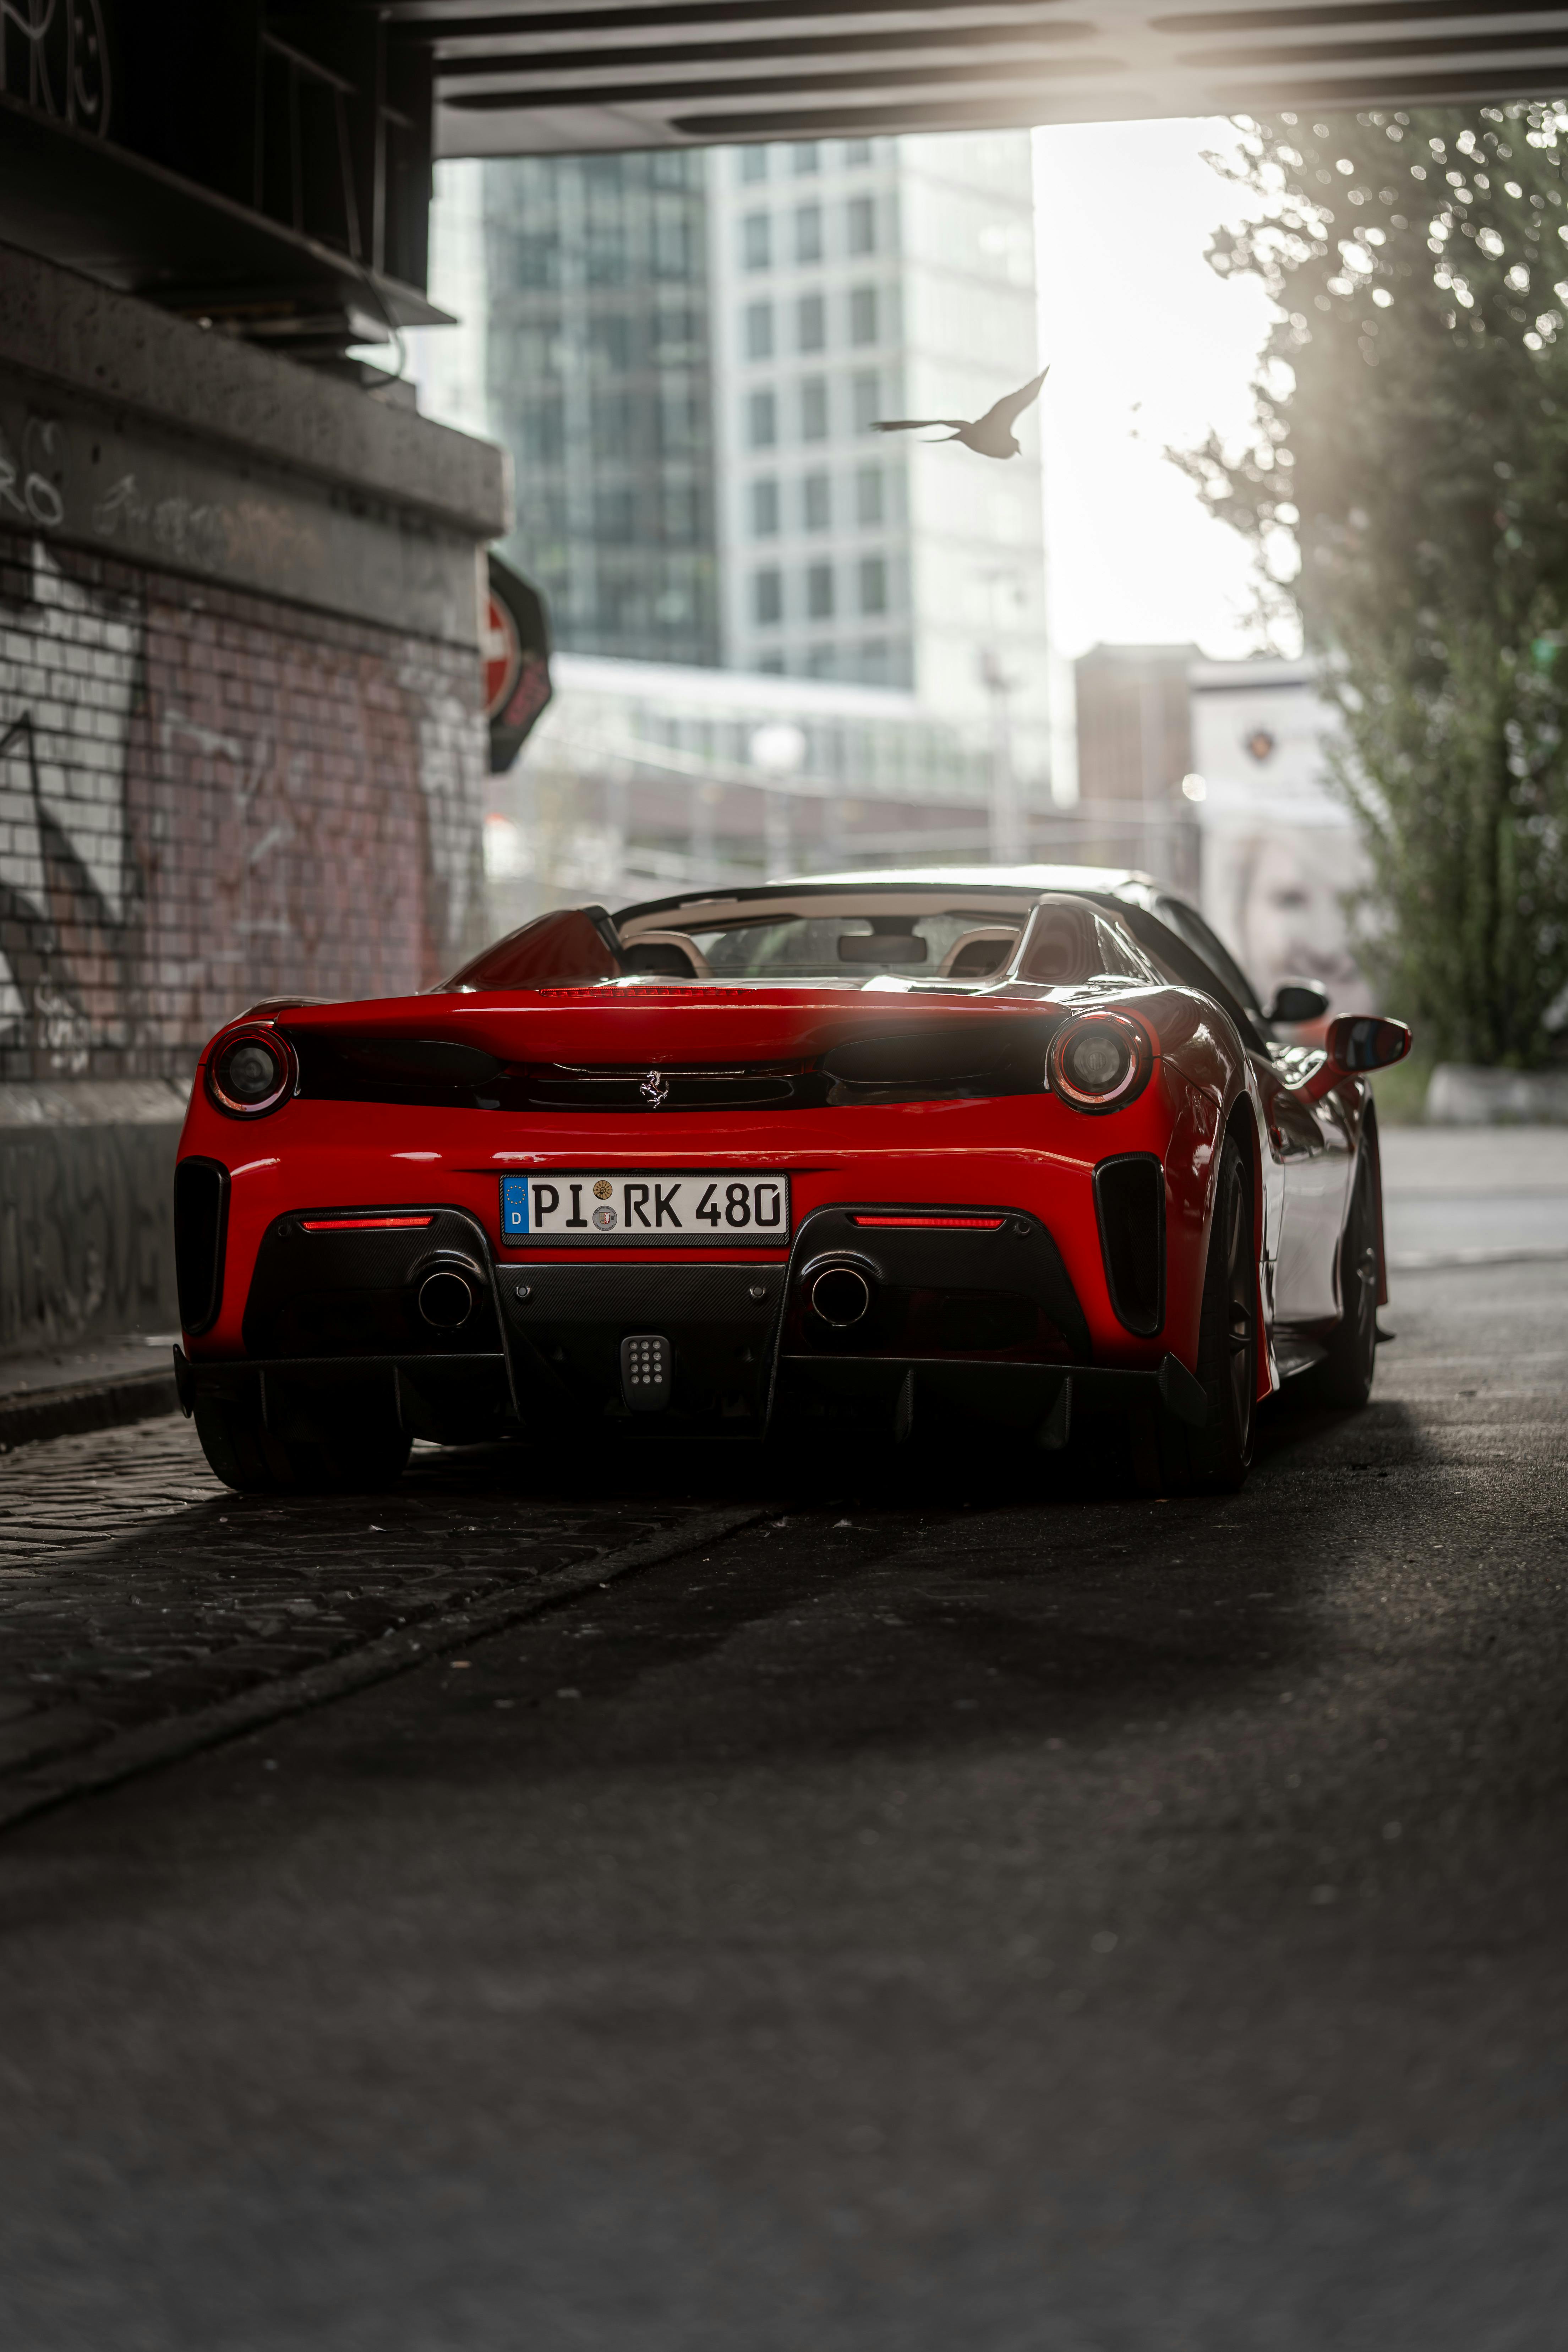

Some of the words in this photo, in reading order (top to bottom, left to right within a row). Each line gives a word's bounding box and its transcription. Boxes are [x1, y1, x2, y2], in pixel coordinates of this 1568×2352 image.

[512, 1212, 521, 1224] D
[532, 1184, 588, 1227] PI
[624, 1184, 683, 1227] RK
[696, 1183, 780, 1227] 480
